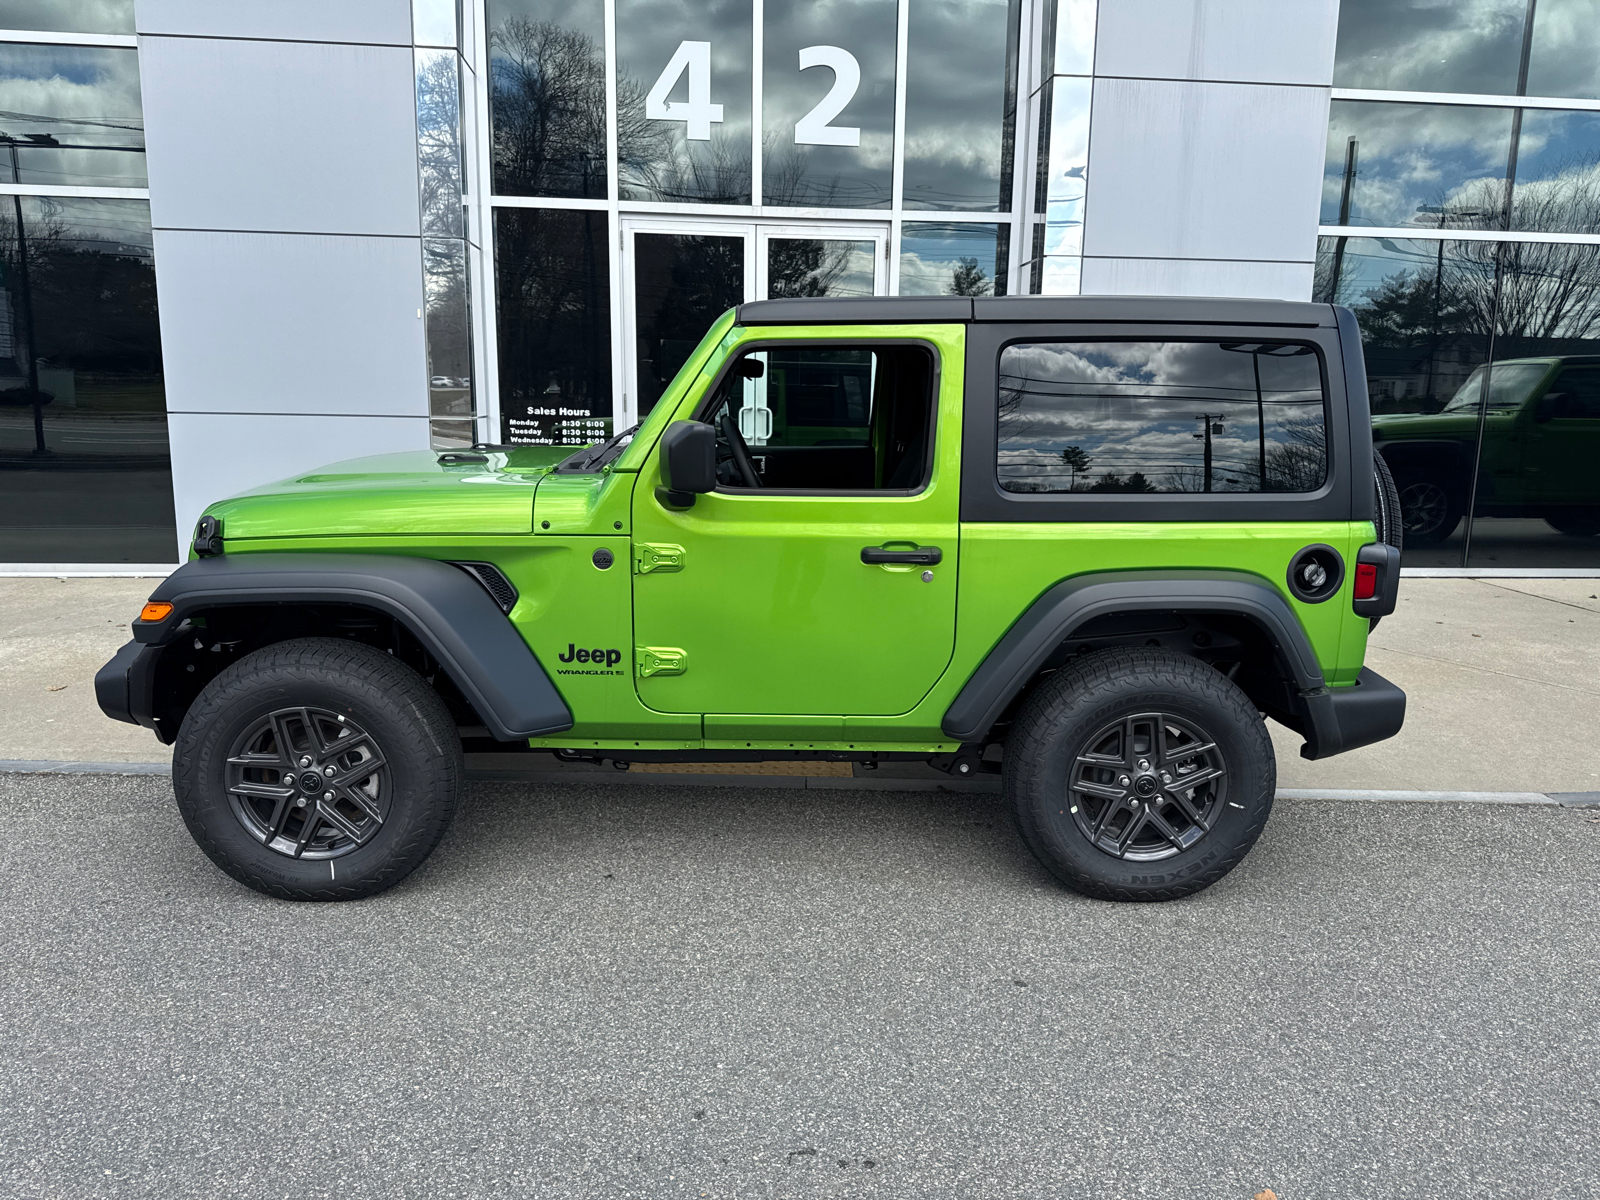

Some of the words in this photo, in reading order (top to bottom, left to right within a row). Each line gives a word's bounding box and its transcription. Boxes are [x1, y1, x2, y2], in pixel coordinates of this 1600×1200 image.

[527, 406, 556, 416] Sales
[559, 407, 591, 417] Hours
[509, 419, 539, 427] Monday
[509, 427, 542, 436] Tuesday
[510, 436, 553, 445] Wednesday
[558, 643, 622, 668] Jeep
[1065, 695, 1139, 747] ROADIAN
[1131, 850, 1218, 885] NEXEN
